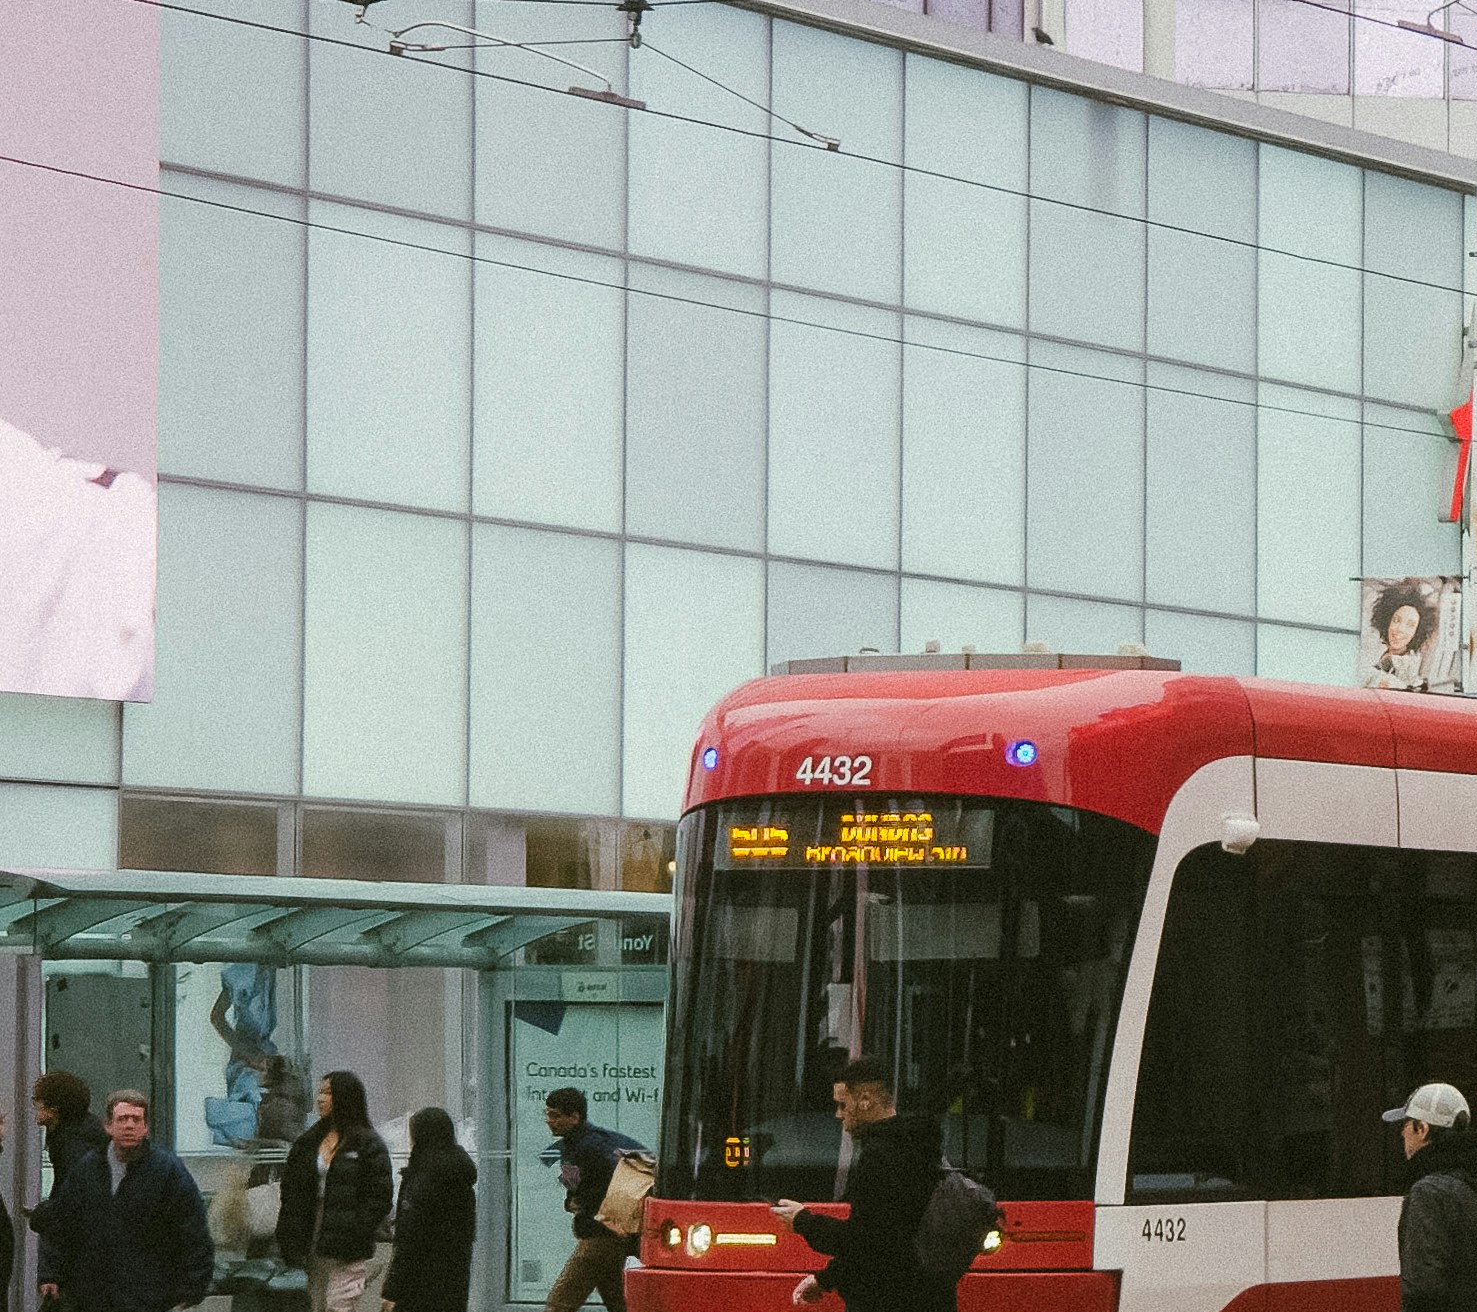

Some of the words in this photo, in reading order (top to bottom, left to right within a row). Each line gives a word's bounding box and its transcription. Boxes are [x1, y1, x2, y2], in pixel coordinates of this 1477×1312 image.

[796, 755, 873, 786] 4432
[526, 1061, 598, 1079] Canada's
[603, 1062, 656, 1080] fastest
[594, 1086, 621, 1104] and
[1141, 1216, 1187, 1243] 4432
